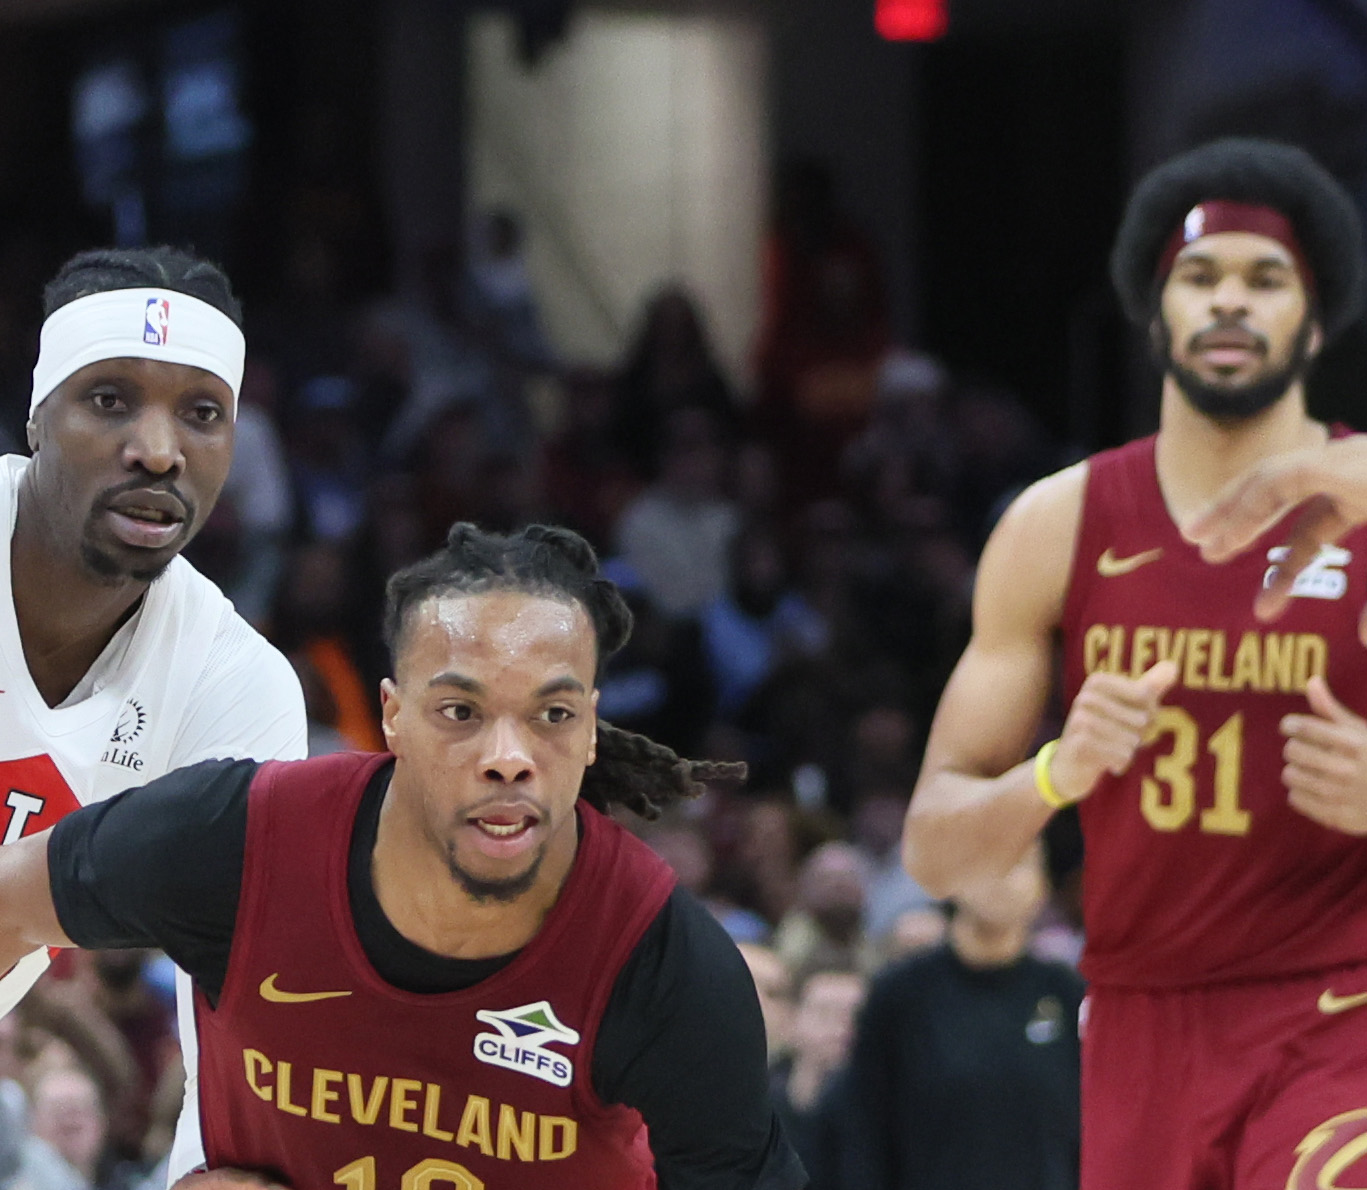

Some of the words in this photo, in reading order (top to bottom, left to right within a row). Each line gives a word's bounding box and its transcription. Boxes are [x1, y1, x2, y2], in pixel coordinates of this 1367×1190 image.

[110, 748, 144, 771] Life
[1140, 705, 1253, 837] 31
[478, 1038, 569, 1080] CLIFFS
[243, 1048, 577, 1162] CLEVELAND
